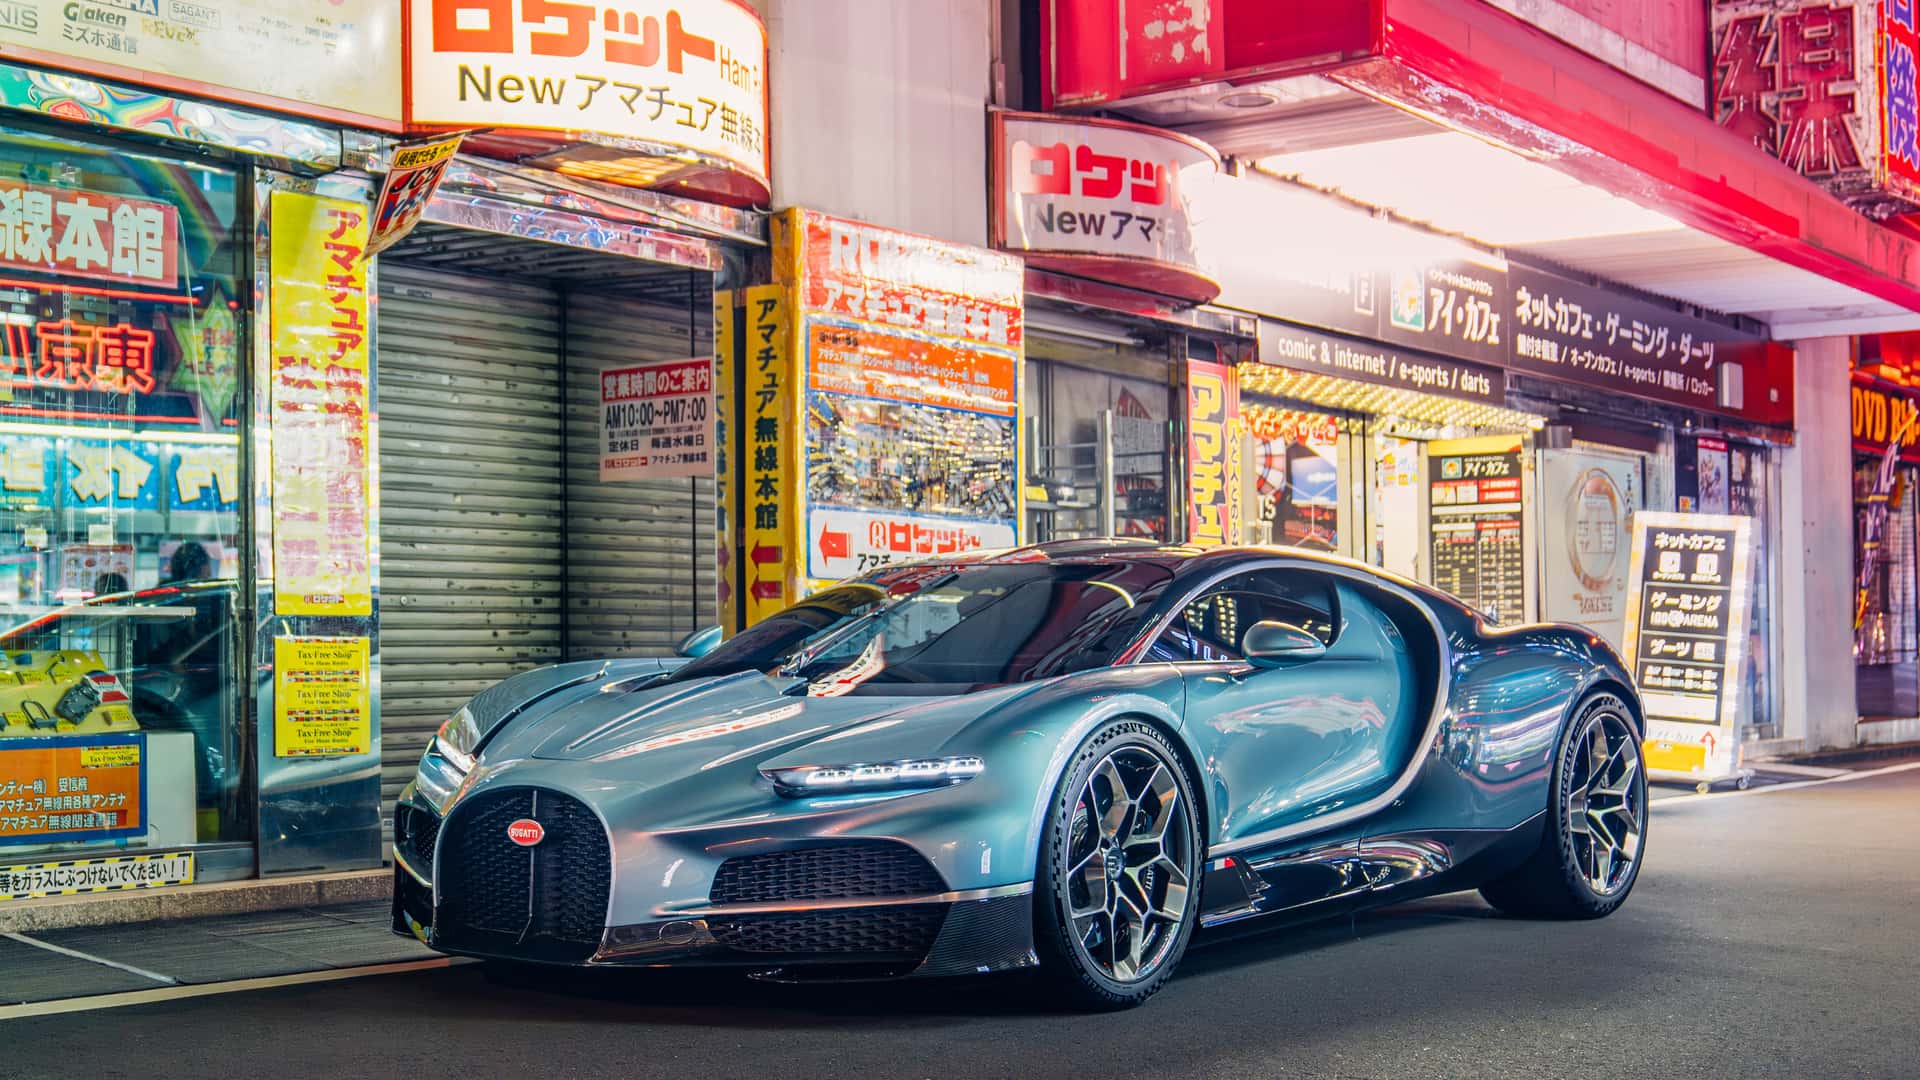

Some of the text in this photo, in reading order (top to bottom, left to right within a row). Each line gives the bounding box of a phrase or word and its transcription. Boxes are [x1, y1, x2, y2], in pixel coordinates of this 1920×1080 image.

[62, 23, 138, 54] ミズホ通信
[433, 0, 716, 74] ロケット
[458, 63, 566, 105] New
[1428, 287, 1501, 345] アイ・カフェ
[604, 366, 709, 400] 営業時間のご案内
[1278, 336, 1317, 365] comic
[1320, 340, 1331, 365] &
[1334, 348, 1386, 378] internet
[1399, 362, 1449, 389] e-sports
[1460, 370, 1491, 395] darts
[754, 297, 779, 531] アマチュア無線本館
[1852, 385, 1887, 443] DVD
[608, 439, 639, 453] 定休日
[1654, 531, 1727, 552] ネットカフェ
[1650, 591, 1723, 612] ゲーミング
[1141, 724, 1179, 761] MICHELIN
[1561, 740, 1576, 809] MICHELIN
[510, 827, 538, 839] BUGATTI
